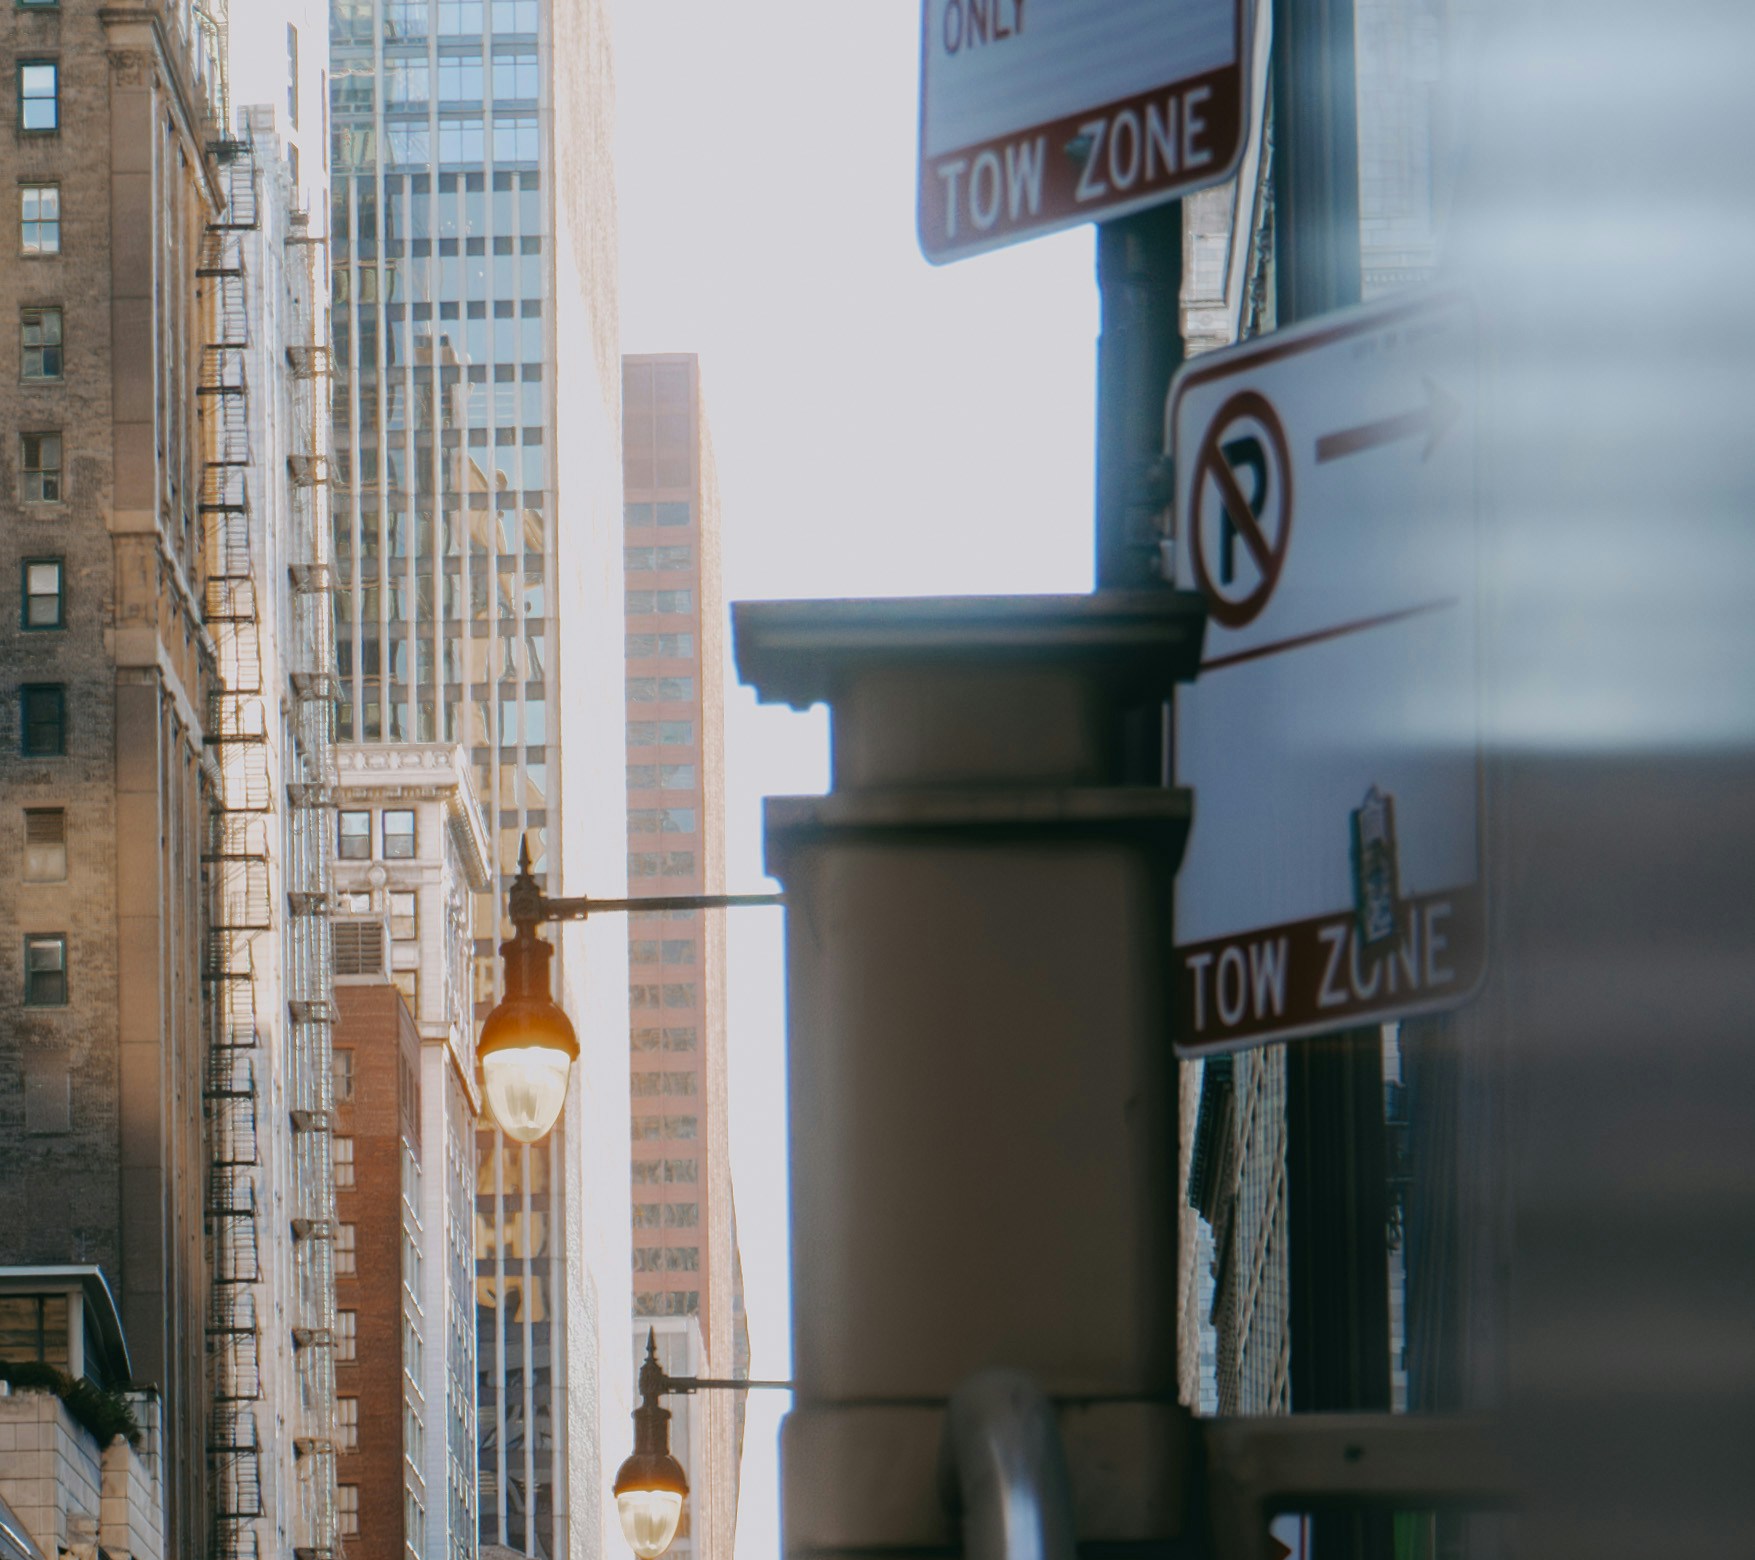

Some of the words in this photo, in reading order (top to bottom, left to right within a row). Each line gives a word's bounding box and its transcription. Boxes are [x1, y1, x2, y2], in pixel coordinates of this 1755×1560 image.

[943, 0, 1026, 55] ONLY
[937, 136, 1046, 239] TOW
[1075, 85, 1213, 202] ZONE
[1185, 935, 1289, 1032] TOW
